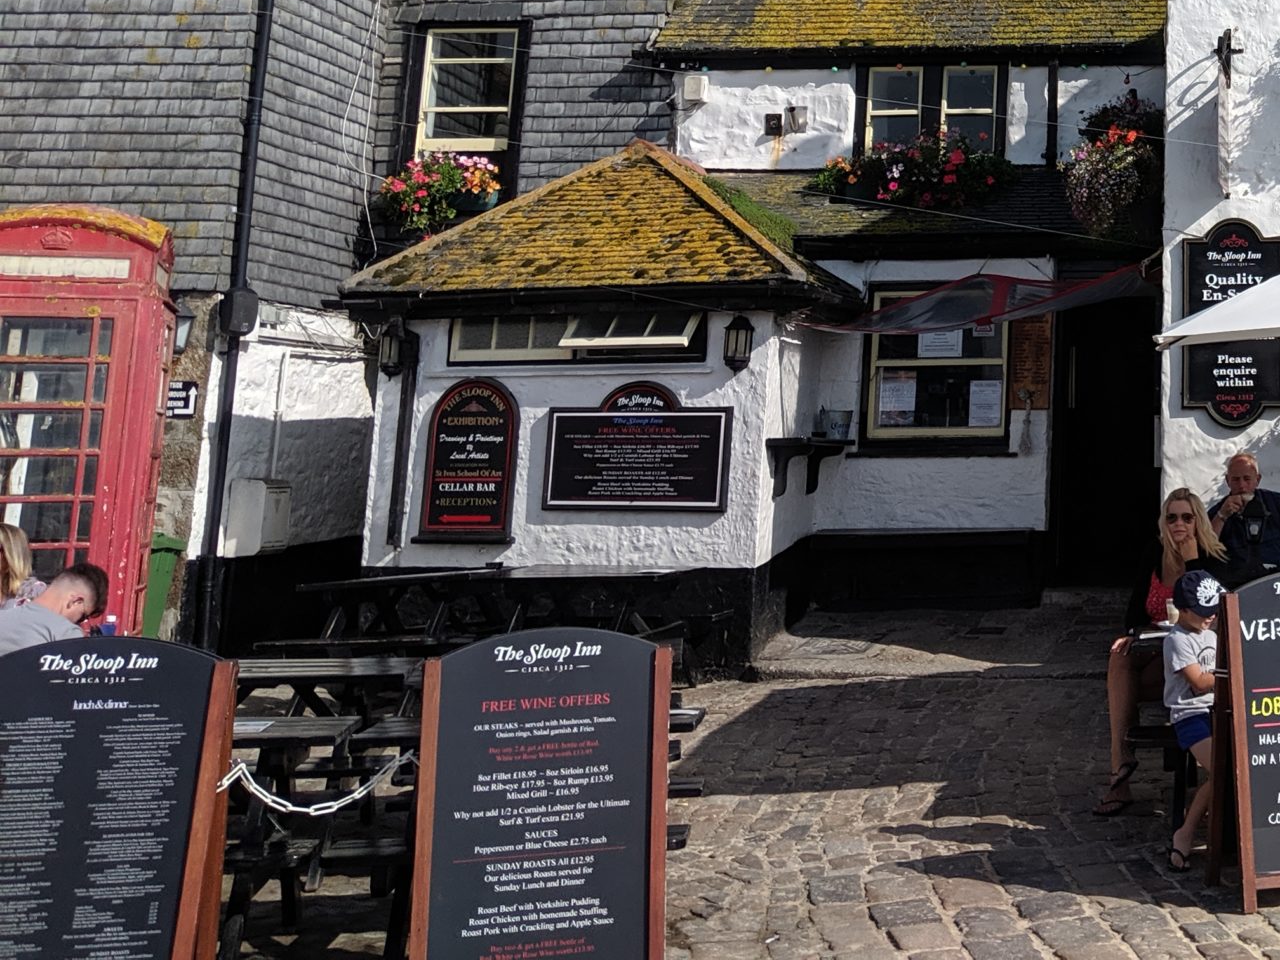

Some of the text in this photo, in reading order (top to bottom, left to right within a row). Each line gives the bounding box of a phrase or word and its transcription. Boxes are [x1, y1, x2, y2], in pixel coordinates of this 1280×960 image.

[1207, 251, 1262, 262] The Sloop Inn
[1205, 273, 1264, 289] Quality
[1202, 289, 1242, 301] En-S
[1217, 355, 1253, 364] Please
[1213, 366, 1257, 378] enquire
[1216, 378, 1254, 387] within
[617, 394, 664, 407] The Sloop Inn
[447, 416, 500, 426] EXHIBITION
[449, 451, 490, 459] Local Artists
[457, 469, 480, 477] School
[439, 483, 496, 492] CELLAR BAR
[440, 498, 492, 506] RECEPTION
[494, 641, 602, 665] The Sloop Inn
[40, 653, 159, 675] The Sloop Inn
[521, 664, 574, 674] CIRCA 1312
[104, 676, 126, 685] 1312
[482, 693, 611, 713] FREE WINE OFFERS
[1251, 754, 1267, 766] ON
[1269, 753, 1277, 765] A
[477, 764, 609, 782] 8oz Fillet £18.95 8oz Sirloin £16.95
[521, 780, 545, 789] £17.95
[553, 778, 566, 786] 8oz
[567, 776, 590, 787] Rump
[590, 774, 614, 784] £13.95
[506, 787, 580, 800] Mixed Grill £16.95
[454, 811, 471, 821] Why
[486, 809, 499, 818] add
[519, 805, 547, 815] Cornish
[548, 803, 575, 812] Lobster
[576, 802, 587, 810] for
[588, 801, 600, 809] the
[600, 799, 631, 808] Ultimate
[525, 829, 558, 840] SAUCES
[486, 856, 595, 872] SUNDAY ROASTS All £12.95
[477, 897, 601, 916] Roast Beef with Yorkshire Pudding
[468, 906, 608, 927] Roast Chicken with homemade Stuffing
